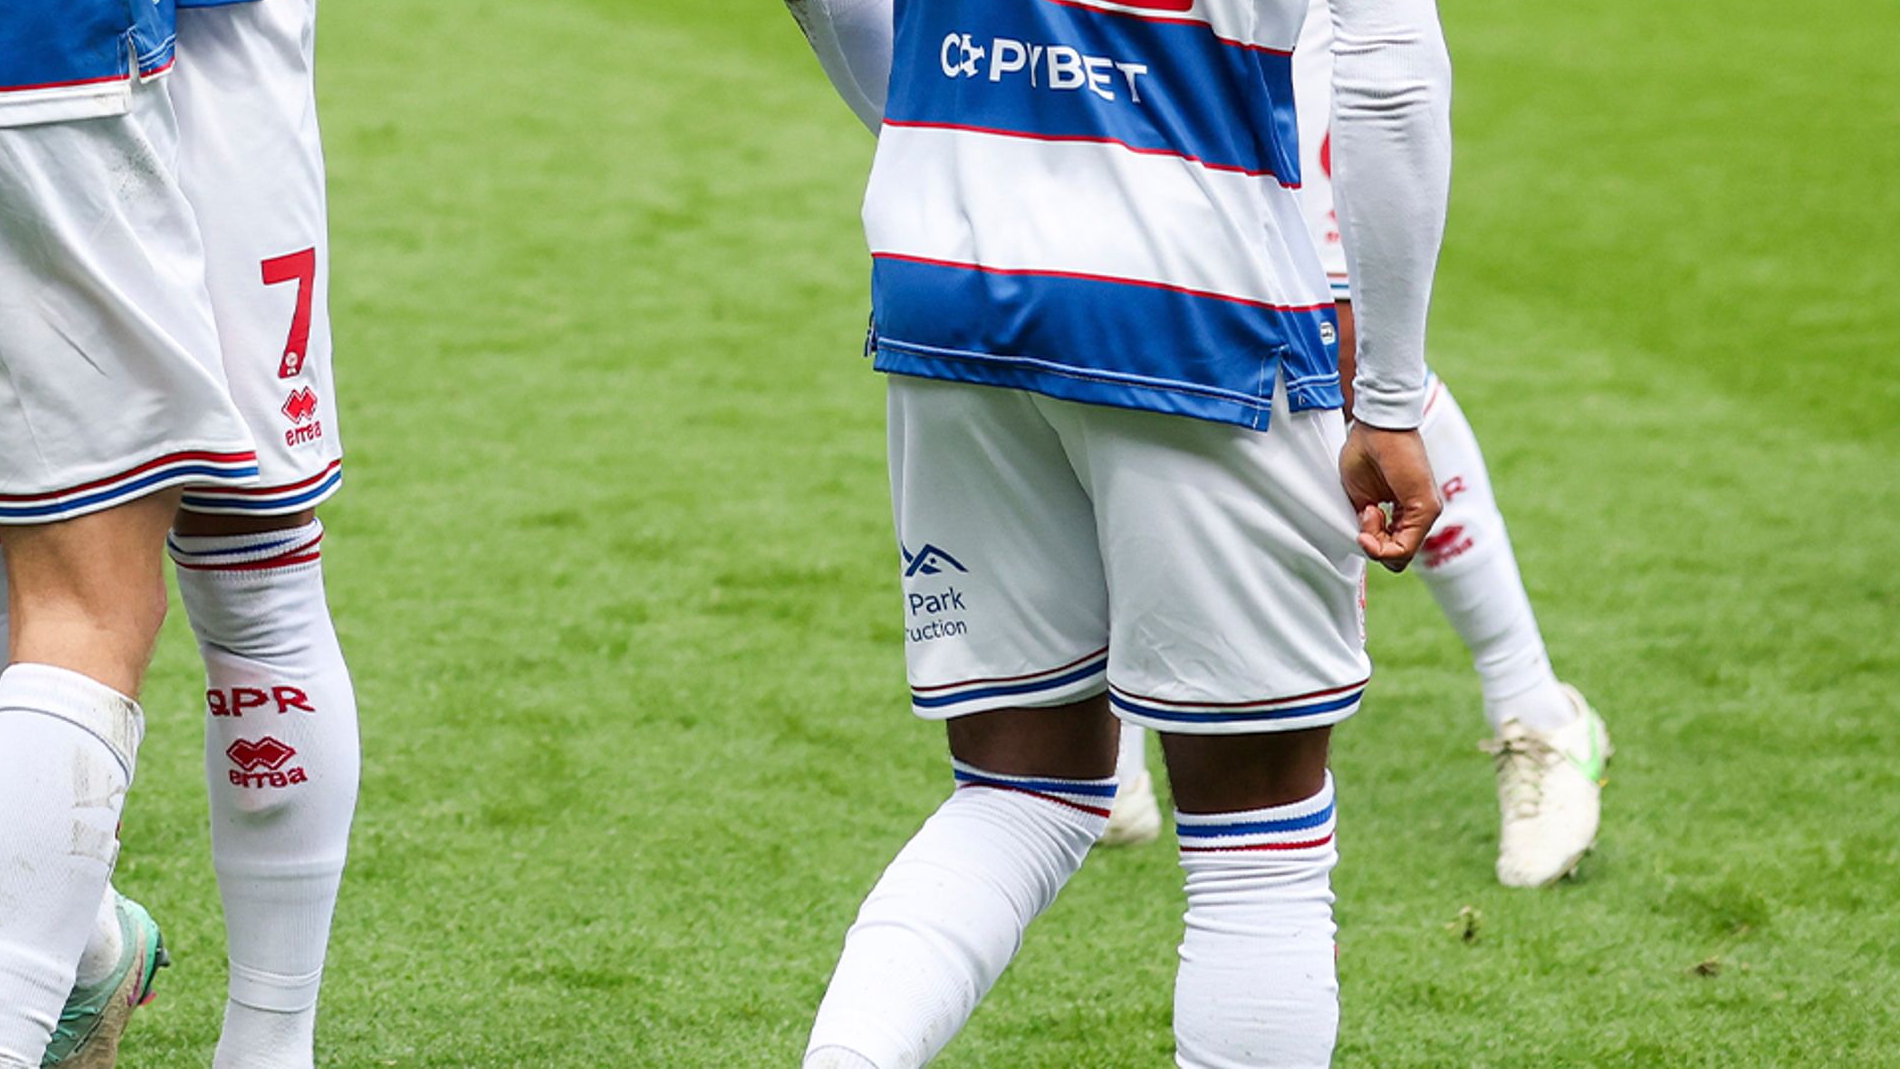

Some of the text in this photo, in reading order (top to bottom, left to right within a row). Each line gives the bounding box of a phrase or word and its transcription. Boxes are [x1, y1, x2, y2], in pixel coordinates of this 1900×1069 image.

[261, 247, 315, 379] 7
[908, 586, 967, 616] Park
[207, 686, 315, 717] QPR
